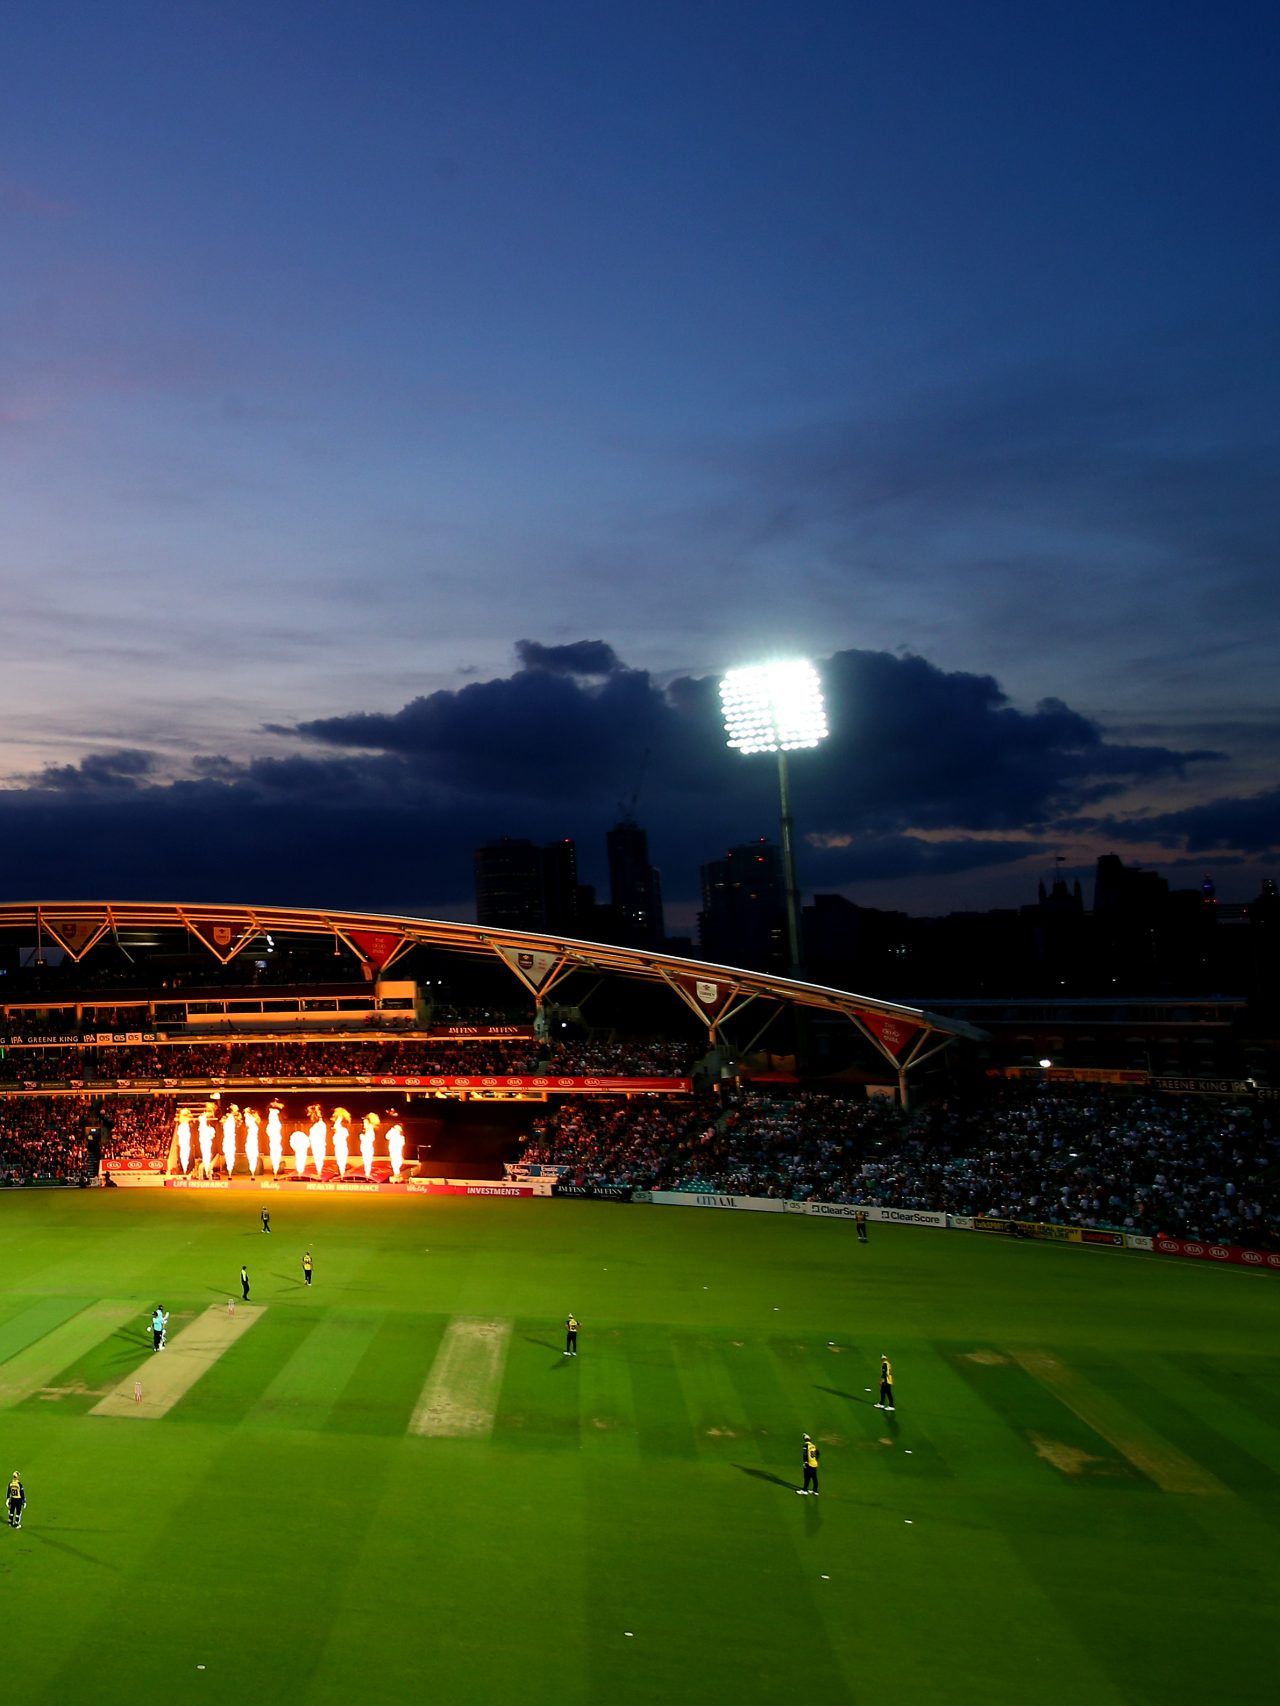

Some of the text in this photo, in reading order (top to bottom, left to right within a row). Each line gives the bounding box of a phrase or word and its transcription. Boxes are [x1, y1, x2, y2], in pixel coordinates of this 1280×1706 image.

[27, 1036, 57, 1044] GREENE
[1156, 1080, 1196, 1089] GREENE
[1199, 1081, 1228, 1091] KING
[336, 1184, 379, 1192] INSURANCE
[467, 1187, 520, 1196] INVESTMENTS
[821, 1206, 869, 1217] ClearSce
[891, 1211, 940, 1223] ClearScore
